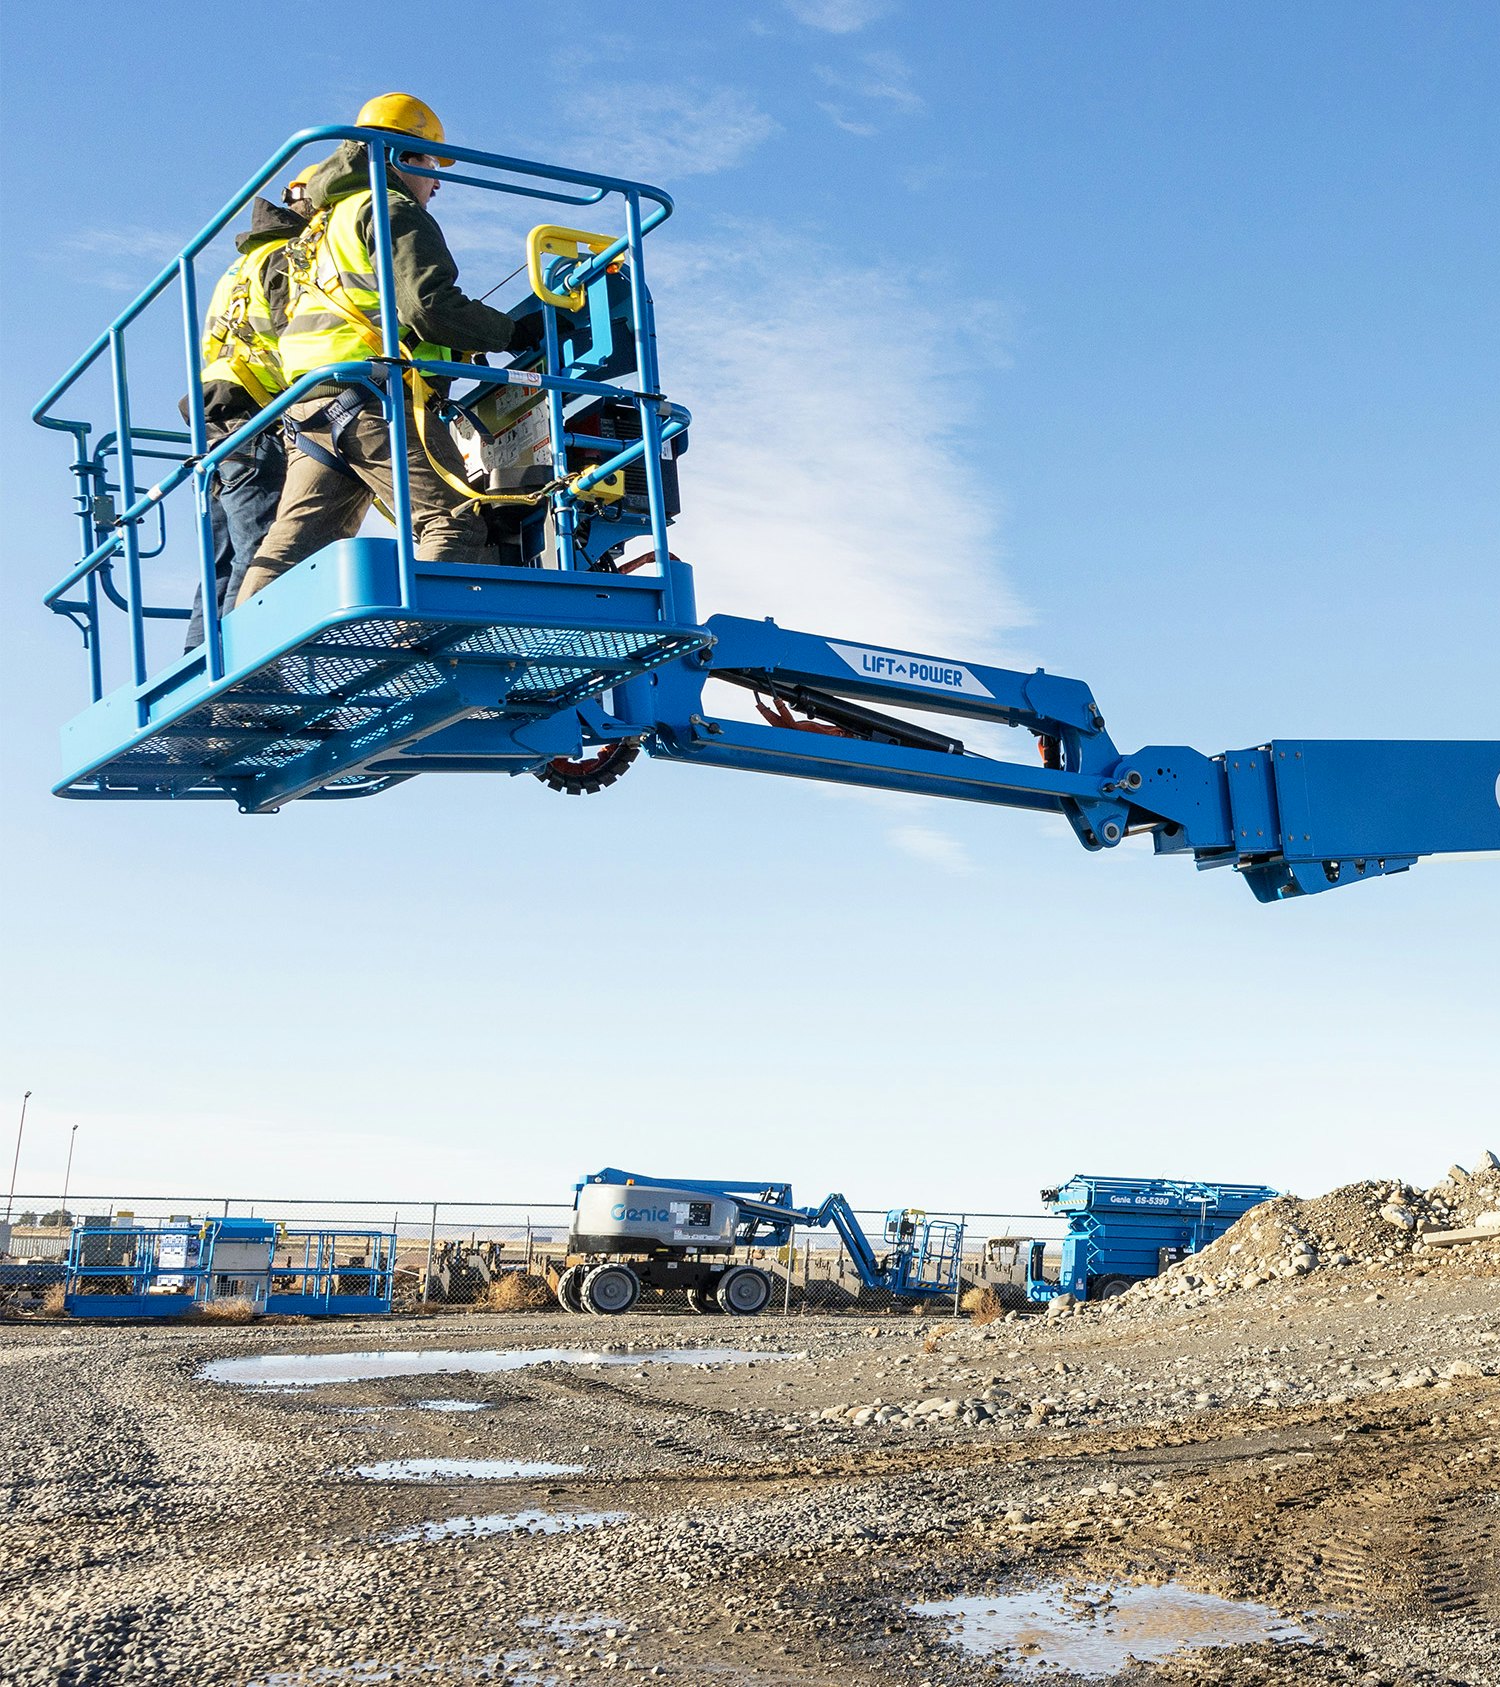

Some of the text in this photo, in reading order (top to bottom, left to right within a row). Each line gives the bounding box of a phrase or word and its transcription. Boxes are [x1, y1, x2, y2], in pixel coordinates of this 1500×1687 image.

[863, 654, 963, 687] LIFT POWER
[1110, 1195, 1169, 1205] Genie GS-5390
[610, 1203, 669, 1221] Genie
